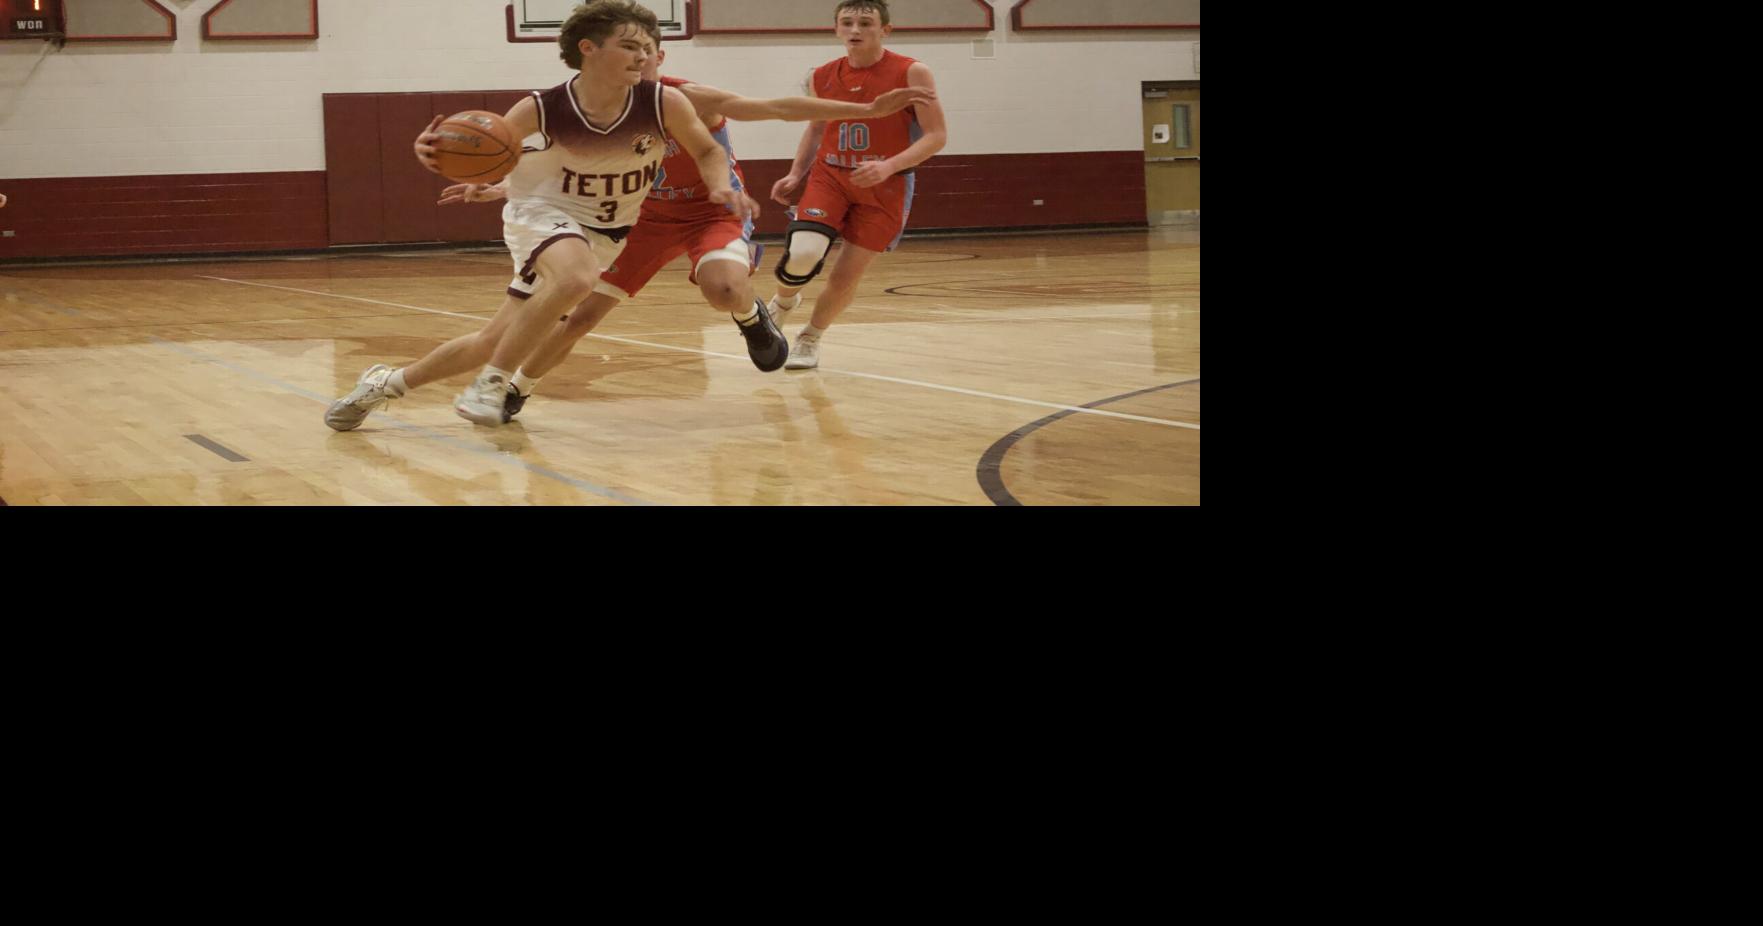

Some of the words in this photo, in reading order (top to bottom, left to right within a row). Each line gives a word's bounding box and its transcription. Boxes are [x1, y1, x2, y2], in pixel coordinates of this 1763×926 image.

[838, 122, 870, 151] 10
[562, 160, 657, 197] TETON
[595, 200, 618, 223] 3
